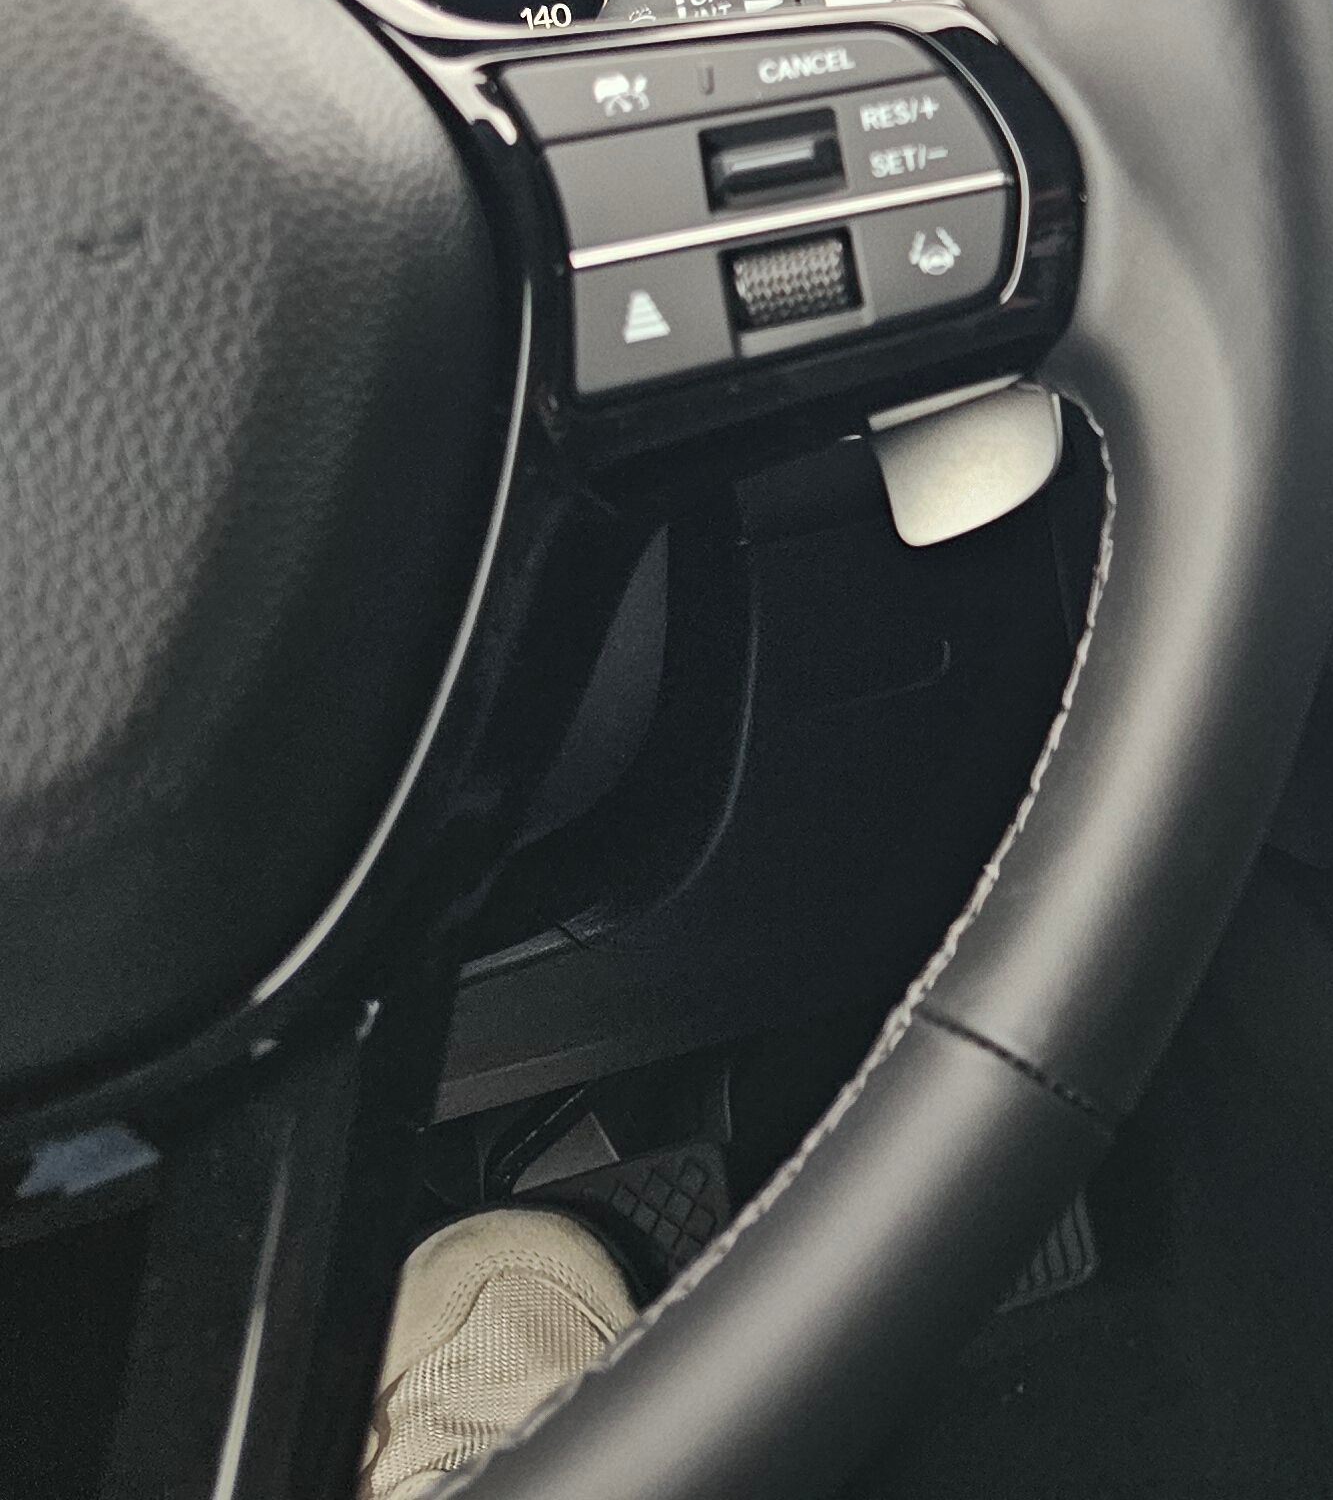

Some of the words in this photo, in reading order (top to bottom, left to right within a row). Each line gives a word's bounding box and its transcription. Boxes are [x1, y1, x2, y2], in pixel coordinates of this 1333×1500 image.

[520, 3, 572, 30] 140
[758, 47, 856, 84] CANCEL
[860, 95, 940, 132] RES/+
